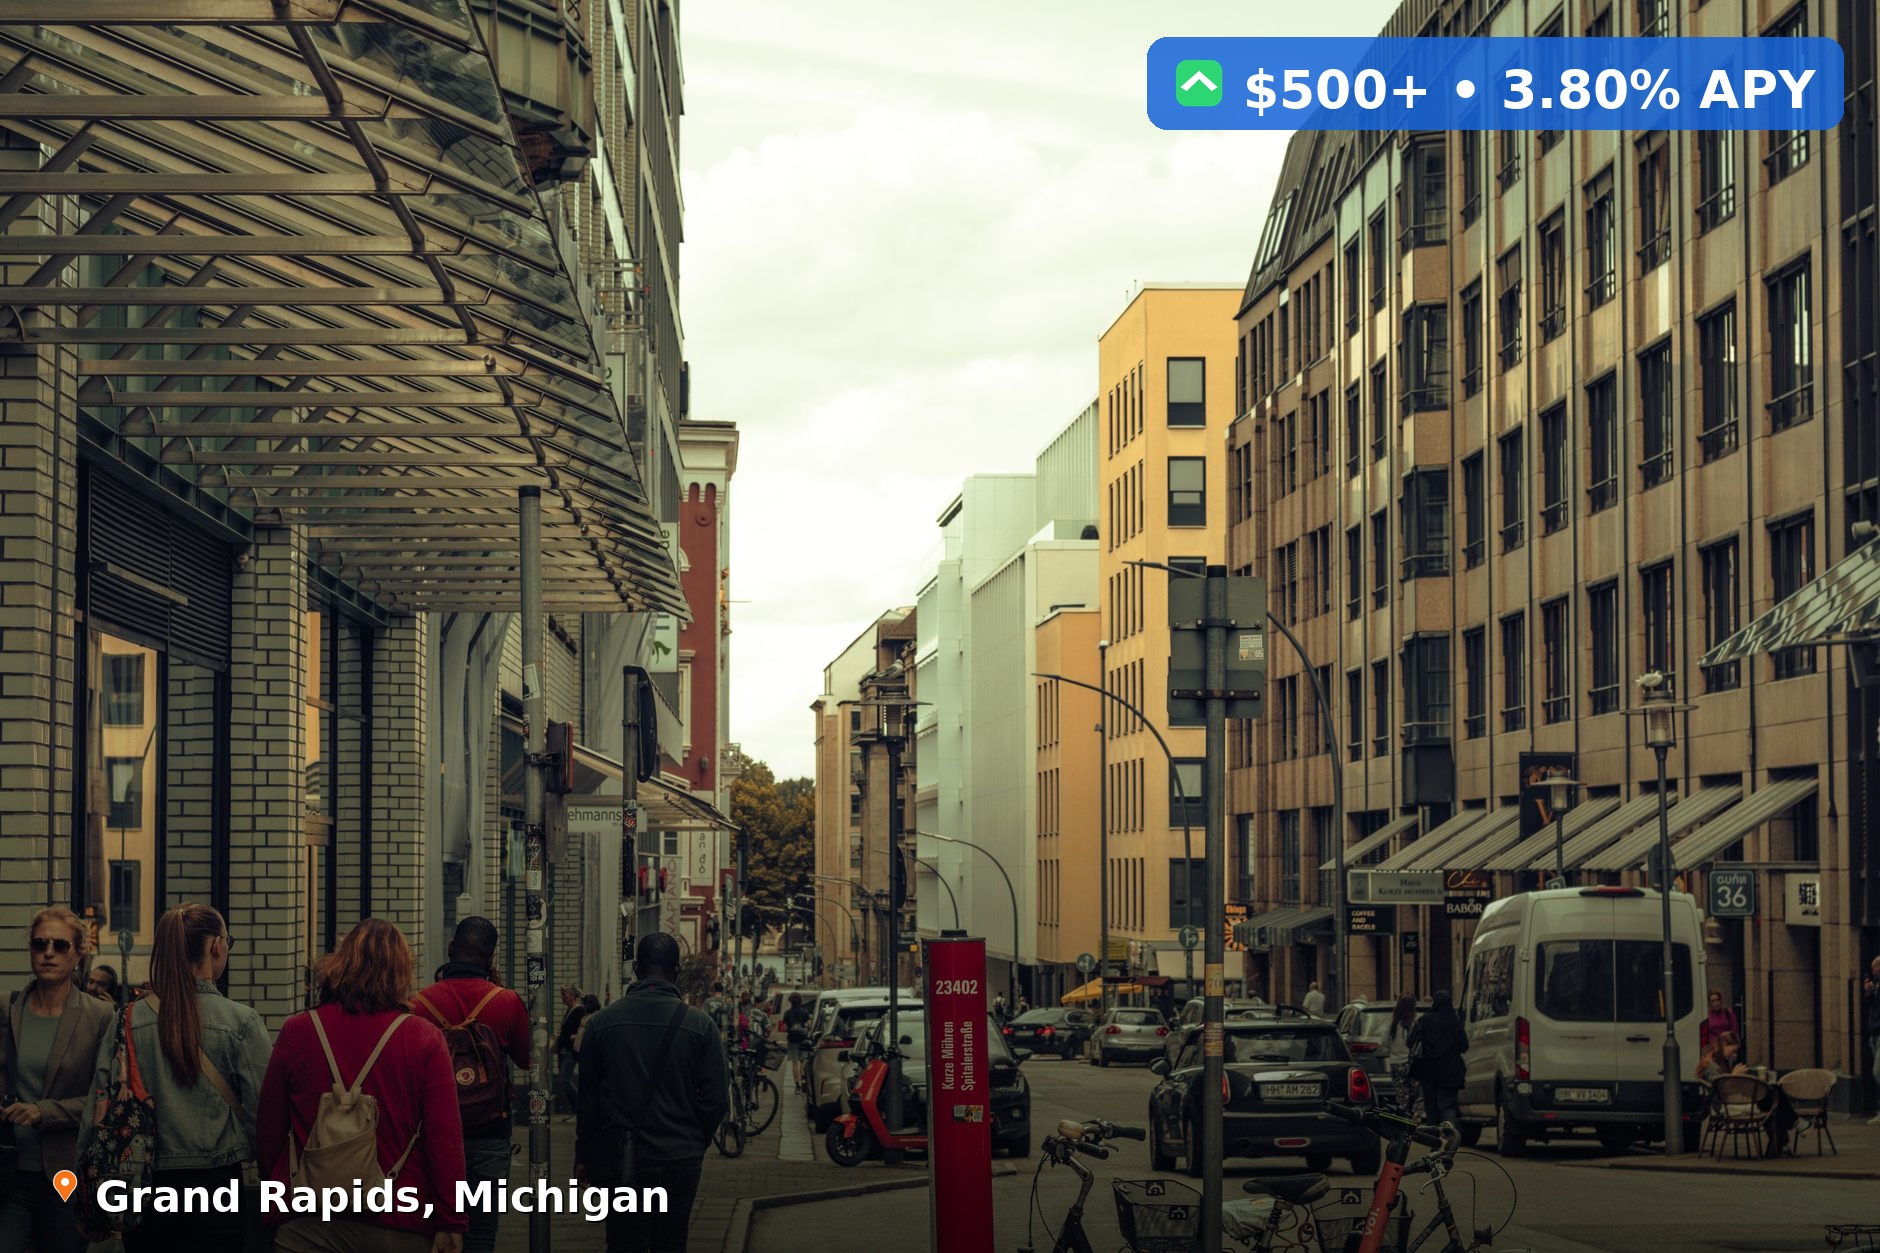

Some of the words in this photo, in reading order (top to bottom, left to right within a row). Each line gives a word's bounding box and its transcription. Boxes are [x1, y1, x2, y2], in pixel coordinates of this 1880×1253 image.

[568, 808, 622, 821] ehmanns
[1717, 885, 1747, 908] 36
[935, 979, 978, 995] 23402
[941, 1021, 954, 1060] Mühren
[960, 1020, 976, 1092] Spitalerstraße
[941, 1062, 954, 1090] Kurze
[1300, 1085, 1318, 1095] 282
